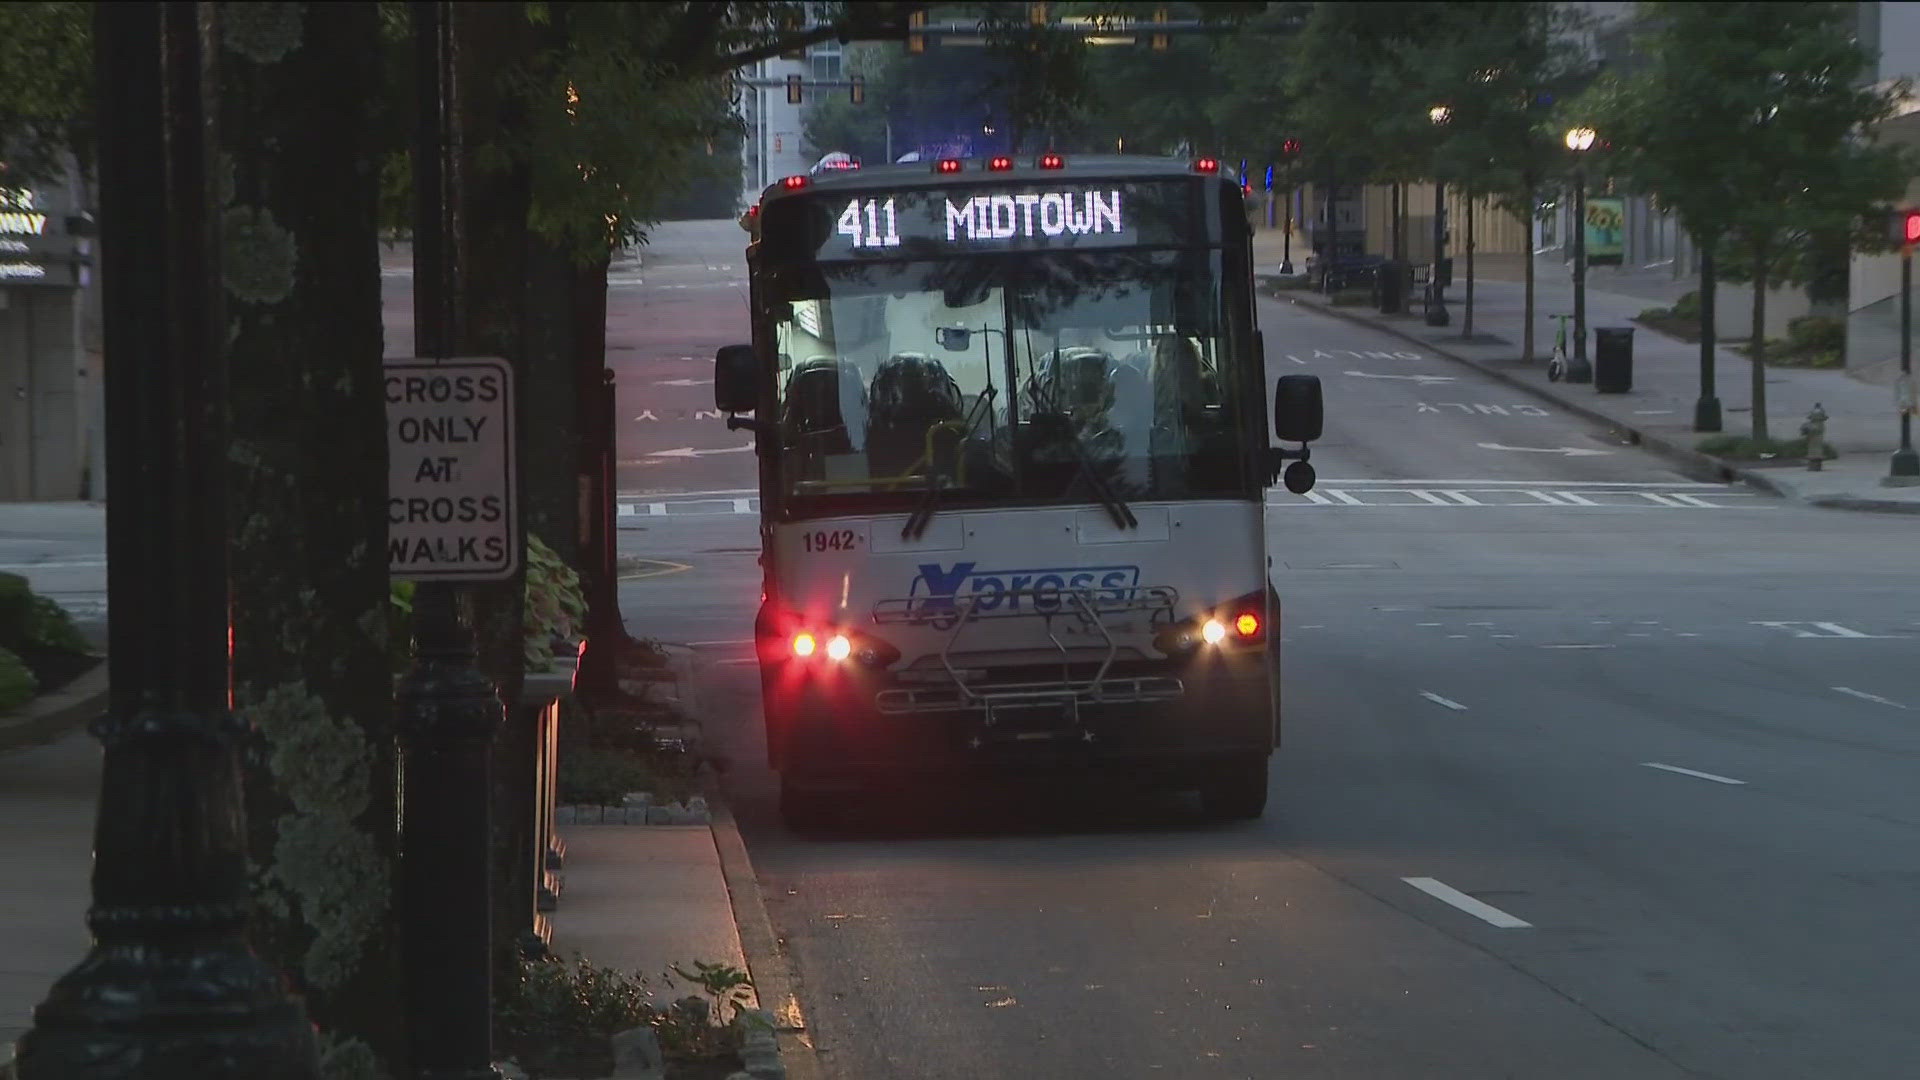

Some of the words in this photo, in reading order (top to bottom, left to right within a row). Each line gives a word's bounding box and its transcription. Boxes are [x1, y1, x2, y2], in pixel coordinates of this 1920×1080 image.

[837, 197, 900, 248] 411
[945, 190, 1121, 242] MIDTOWN
[385, 376, 499, 403] CROSS
[399, 416, 487, 443] ONLY
[415, 457, 459, 483] AT
[389, 497, 501, 524] CROSS
[802, 530, 855, 553] 1942
[916, 562, 1128, 618] Xpress
